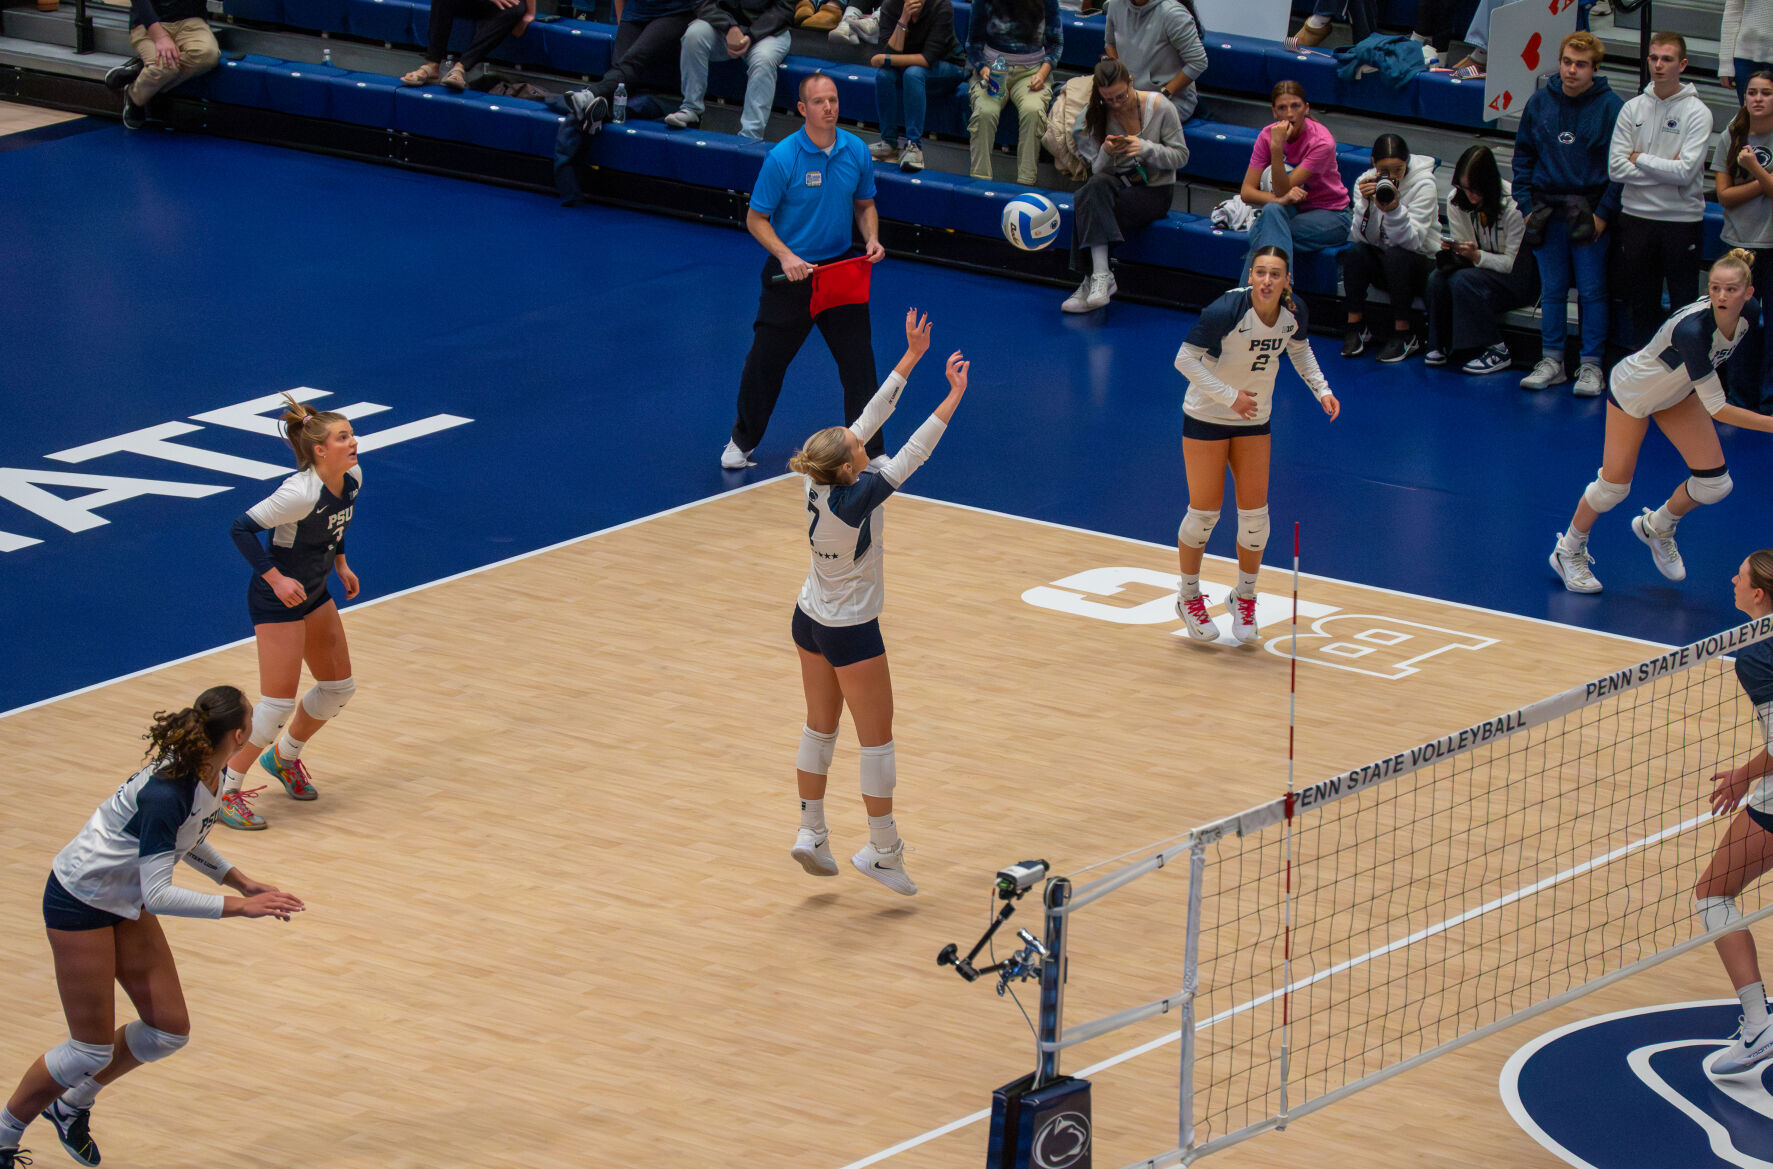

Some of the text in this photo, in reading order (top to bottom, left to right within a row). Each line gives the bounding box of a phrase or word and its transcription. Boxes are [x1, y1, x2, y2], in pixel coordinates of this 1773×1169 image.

[1248, 338, 1283, 351] PSU
[1250, 353, 1271, 372] 2
[0, 386, 475, 552] ATE
[327, 505, 354, 530] PSU
[1586, 669, 1633, 702] PENN
[1638, 647, 1690, 683] STATE
[1347, 754, 1405, 791] STATE
[1411, 709, 1527, 767] VOLLEYBALL
